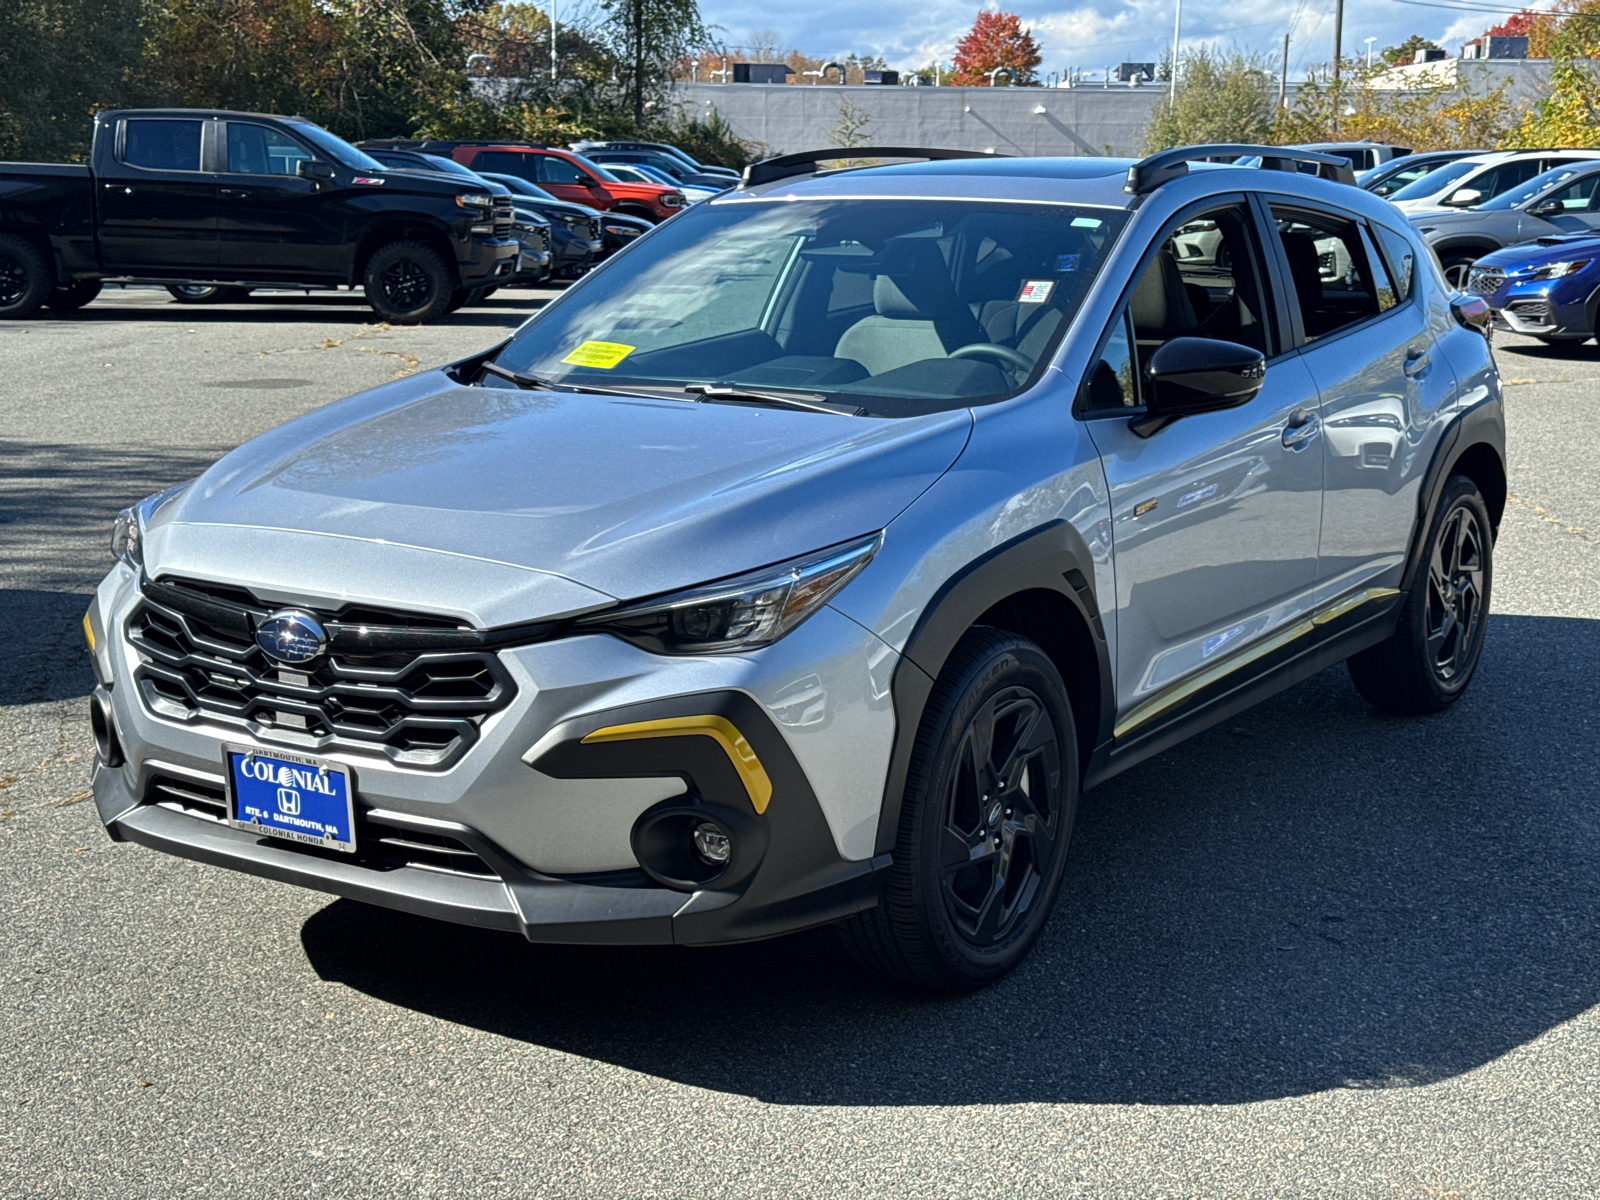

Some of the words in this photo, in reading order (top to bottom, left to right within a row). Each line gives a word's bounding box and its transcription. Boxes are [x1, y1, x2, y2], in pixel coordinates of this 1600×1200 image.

[959, 658, 1009, 720] FALKEN
[253, 749, 304, 763] DARTMOUTH,
[241, 758, 335, 796] COLONIAL
[245, 806, 262, 816] RTE.
[273, 813, 324, 832] DARTMOUTH,
[325, 824, 338, 834] MA
[258, 826, 296, 839] COLONIAL
[297, 835, 324, 845] HONDA
